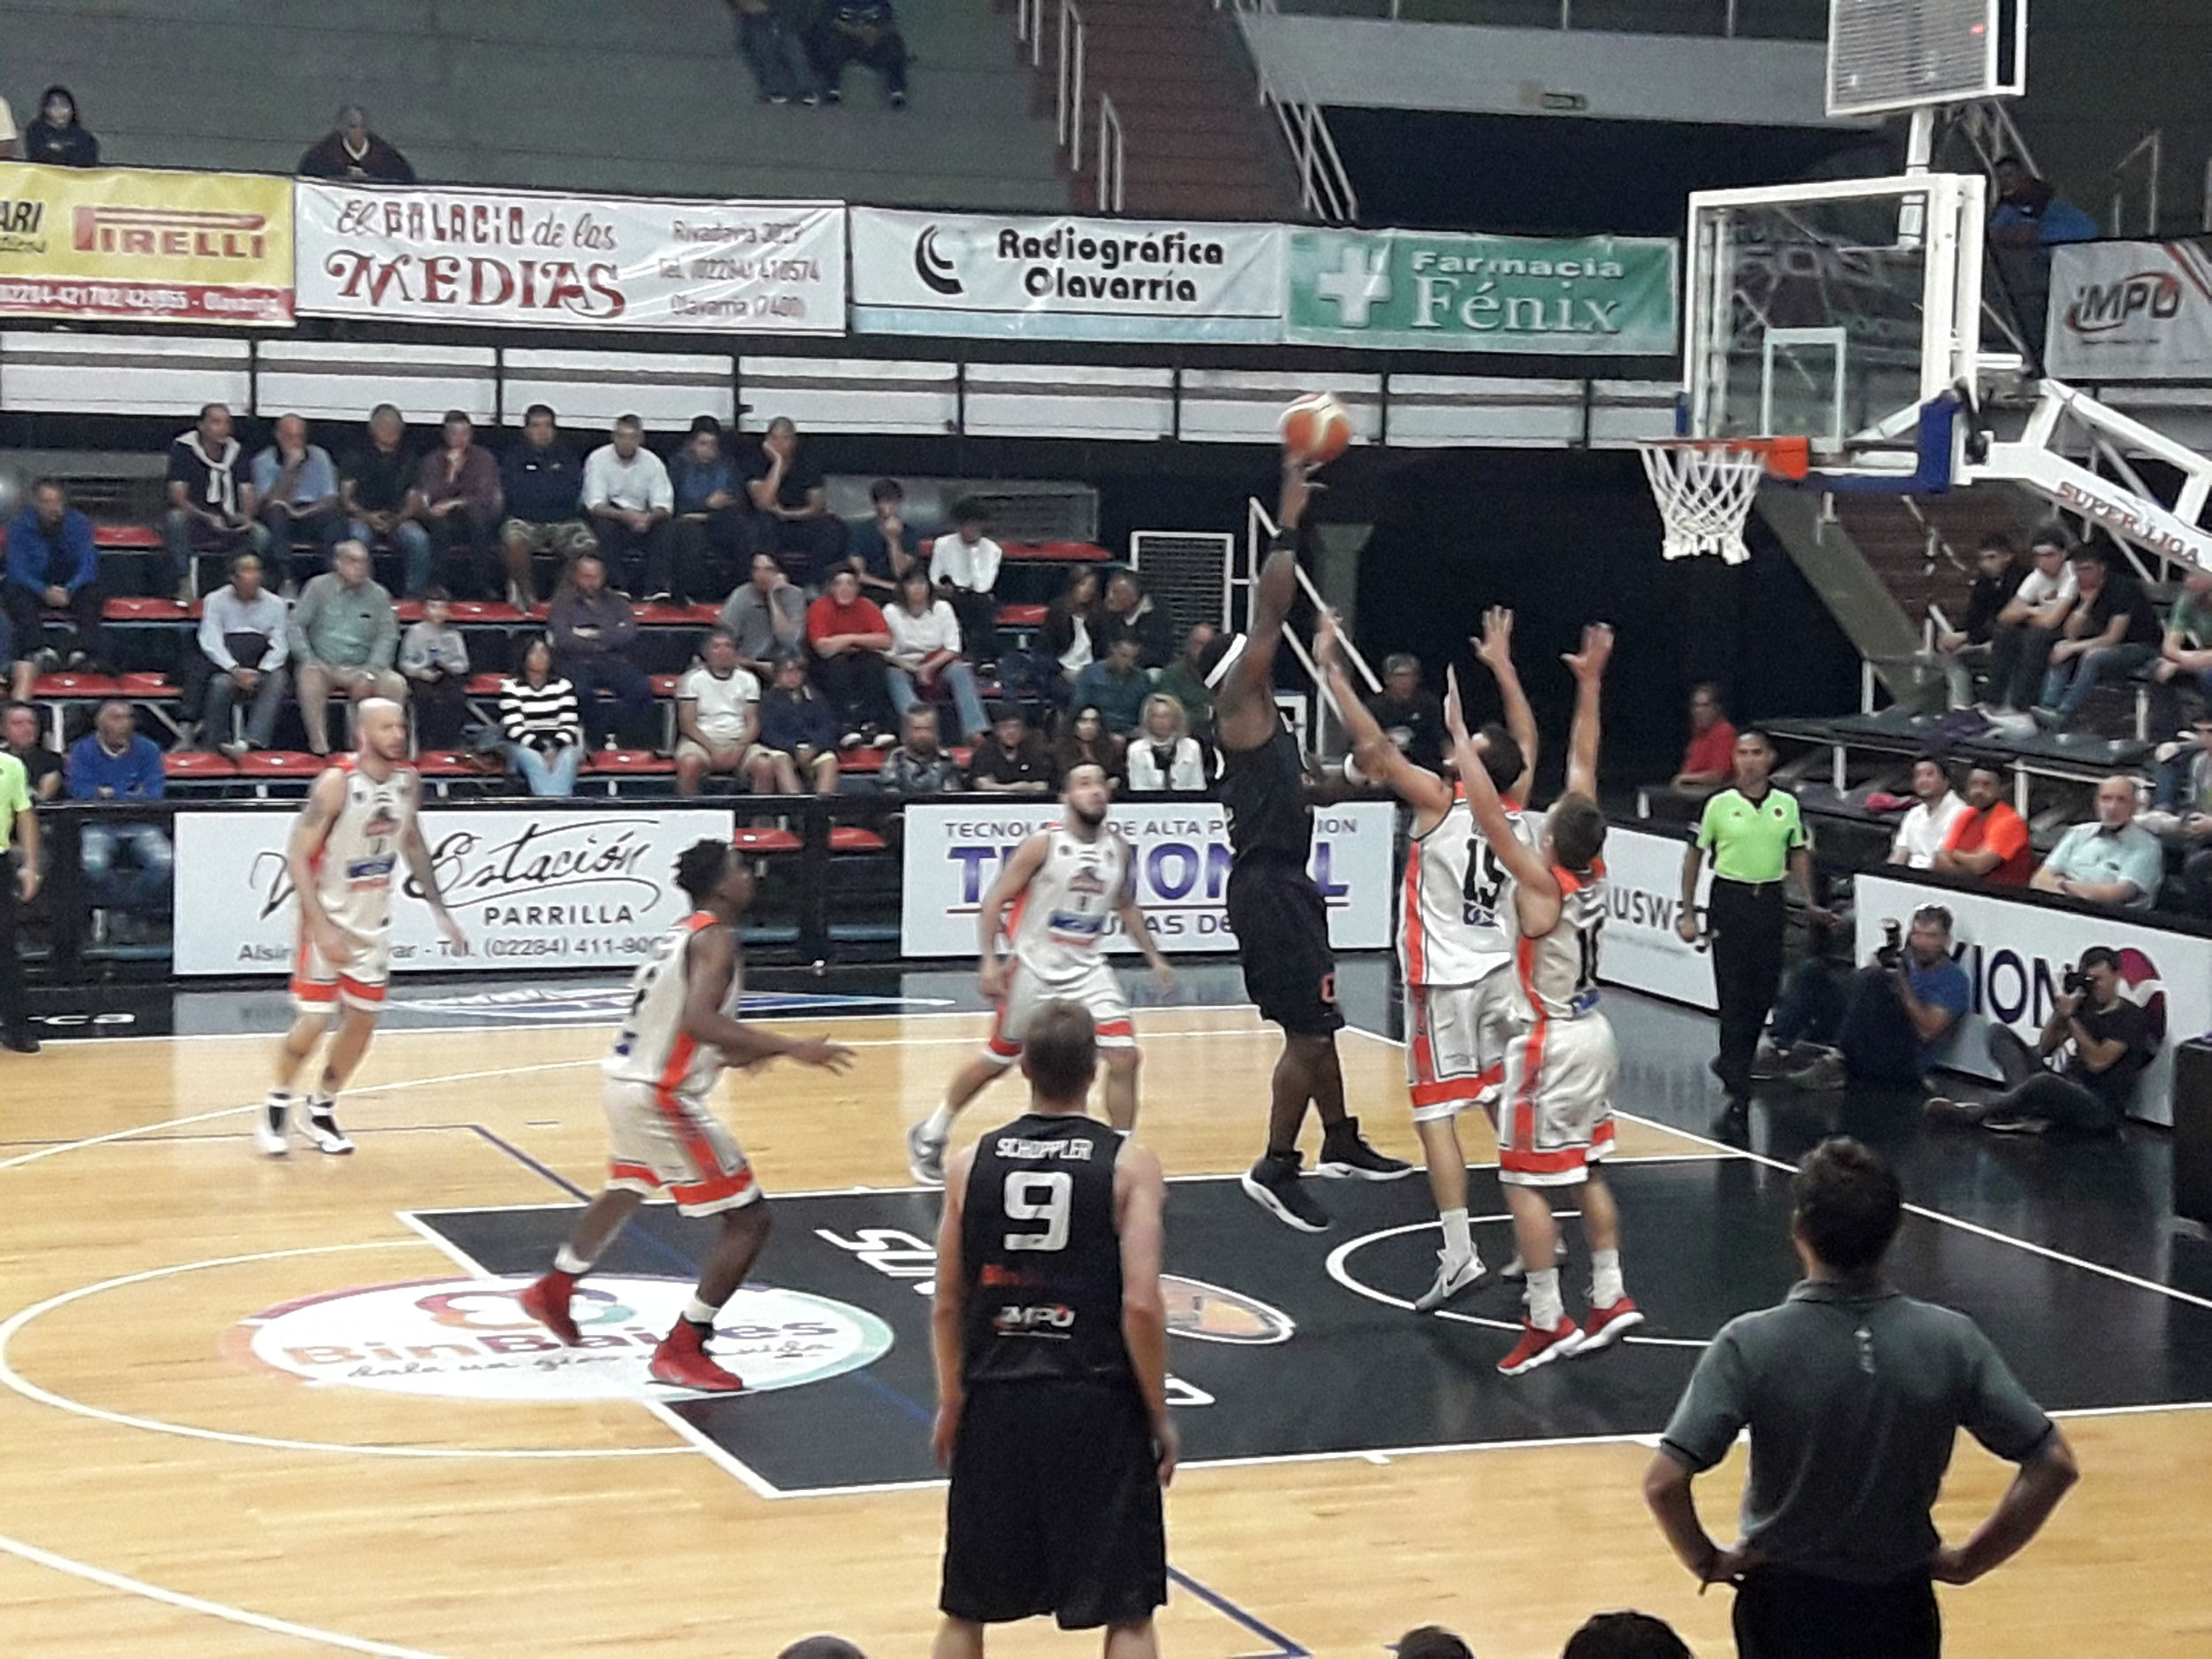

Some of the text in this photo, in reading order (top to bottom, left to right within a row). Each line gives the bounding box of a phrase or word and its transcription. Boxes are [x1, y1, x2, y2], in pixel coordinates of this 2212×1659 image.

[73, 204, 266, 258] PIRELLI
[337, 199, 377, 235] El
[533, 209, 566, 249] de
[574, 212, 618, 251] las
[998, 226, 1225, 270] Radiográfica
[326, 249, 626, 319] MEDIAS
[1025, 266, 1198, 302] Olavarría
[1412, 250, 1625, 279] Farmacia
[1411, 276, 1620, 334] Fénix
[1144, 819, 1202, 835] ALTA
[404, 821, 657, 900] Estación
[486, 905, 634, 926] PARRILLA
[1003, 1170, 1072, 1251] 9
[282, 1322, 839, 1366] BinBaies
